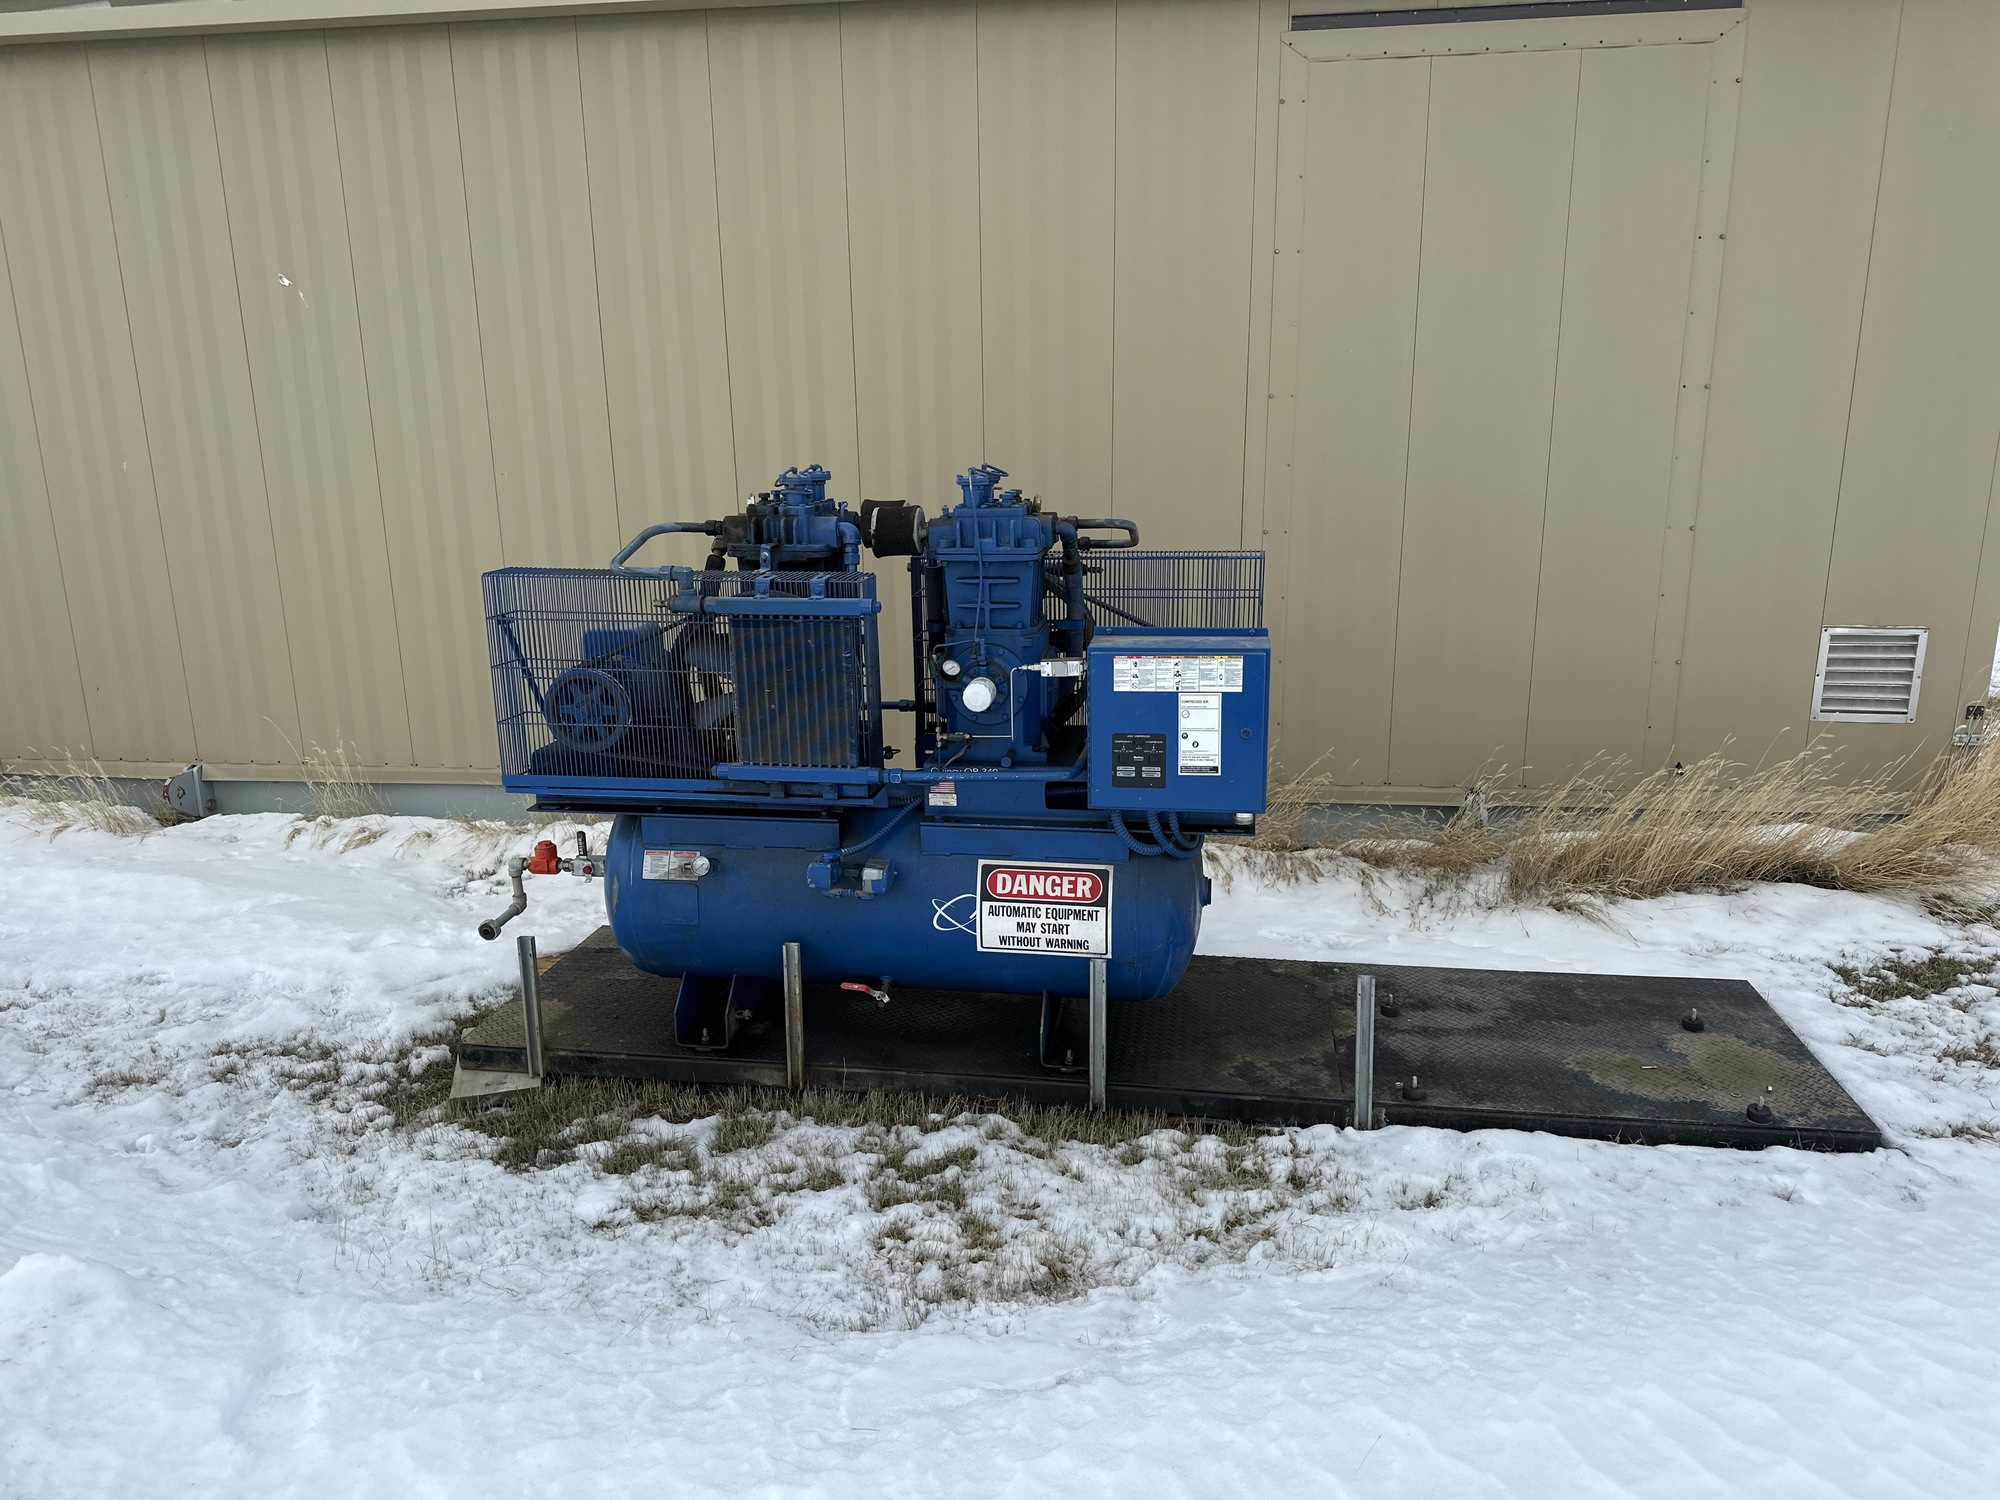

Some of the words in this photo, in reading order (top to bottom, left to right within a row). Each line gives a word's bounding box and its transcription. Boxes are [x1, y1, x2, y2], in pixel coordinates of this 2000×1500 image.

[996, 873, 1092, 898] DANGER
[988, 905, 1042, 919] AUTOMATIC
[1045, 907, 1100, 922] EQUIPMENT
[1016, 921, 1037, 934] MAY
[1040, 923, 1071, 935] START
[998, 935, 1041, 948] WITHOUT
[1045, 937, 1090, 950] WARNING
